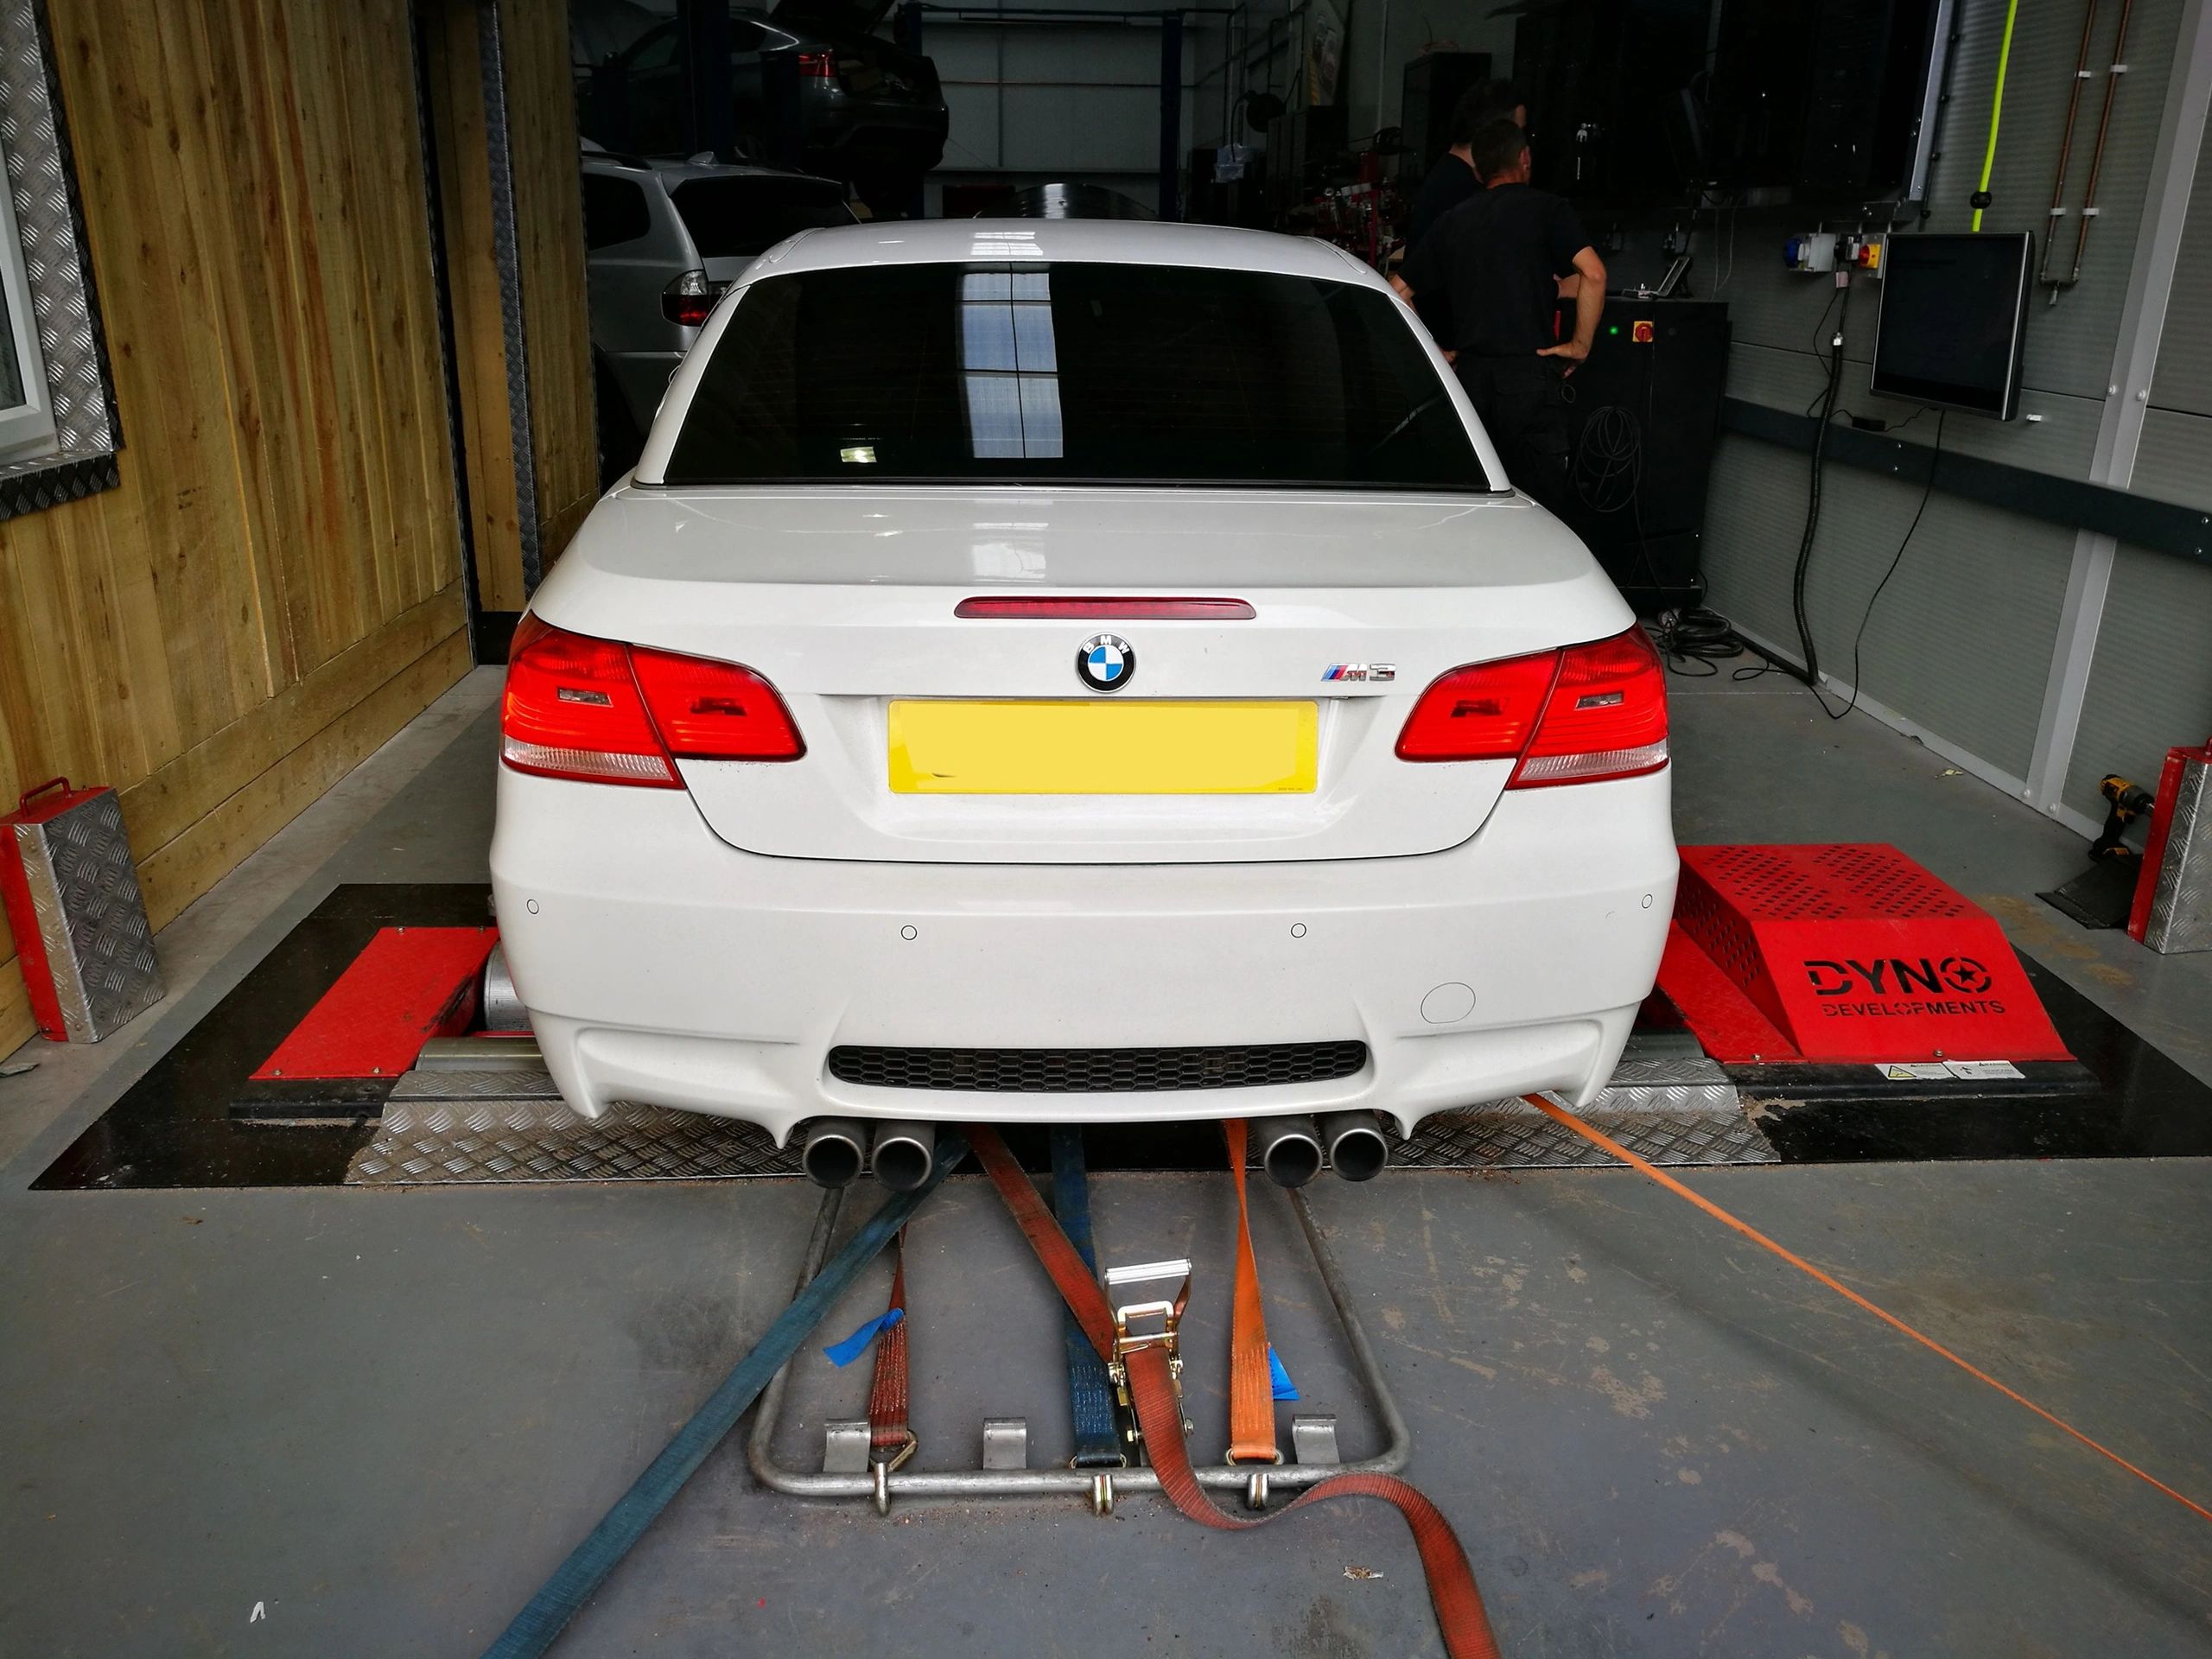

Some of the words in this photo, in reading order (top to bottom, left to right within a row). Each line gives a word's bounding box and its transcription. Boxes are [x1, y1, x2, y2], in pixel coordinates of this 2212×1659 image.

[1082, 635, 1130, 654] BMW
[1321, 663, 1396, 682] M3
[1803, 957, 1993, 995] DYNO
[1822, 1000, 2006, 1017] DEVELOPMENTS
